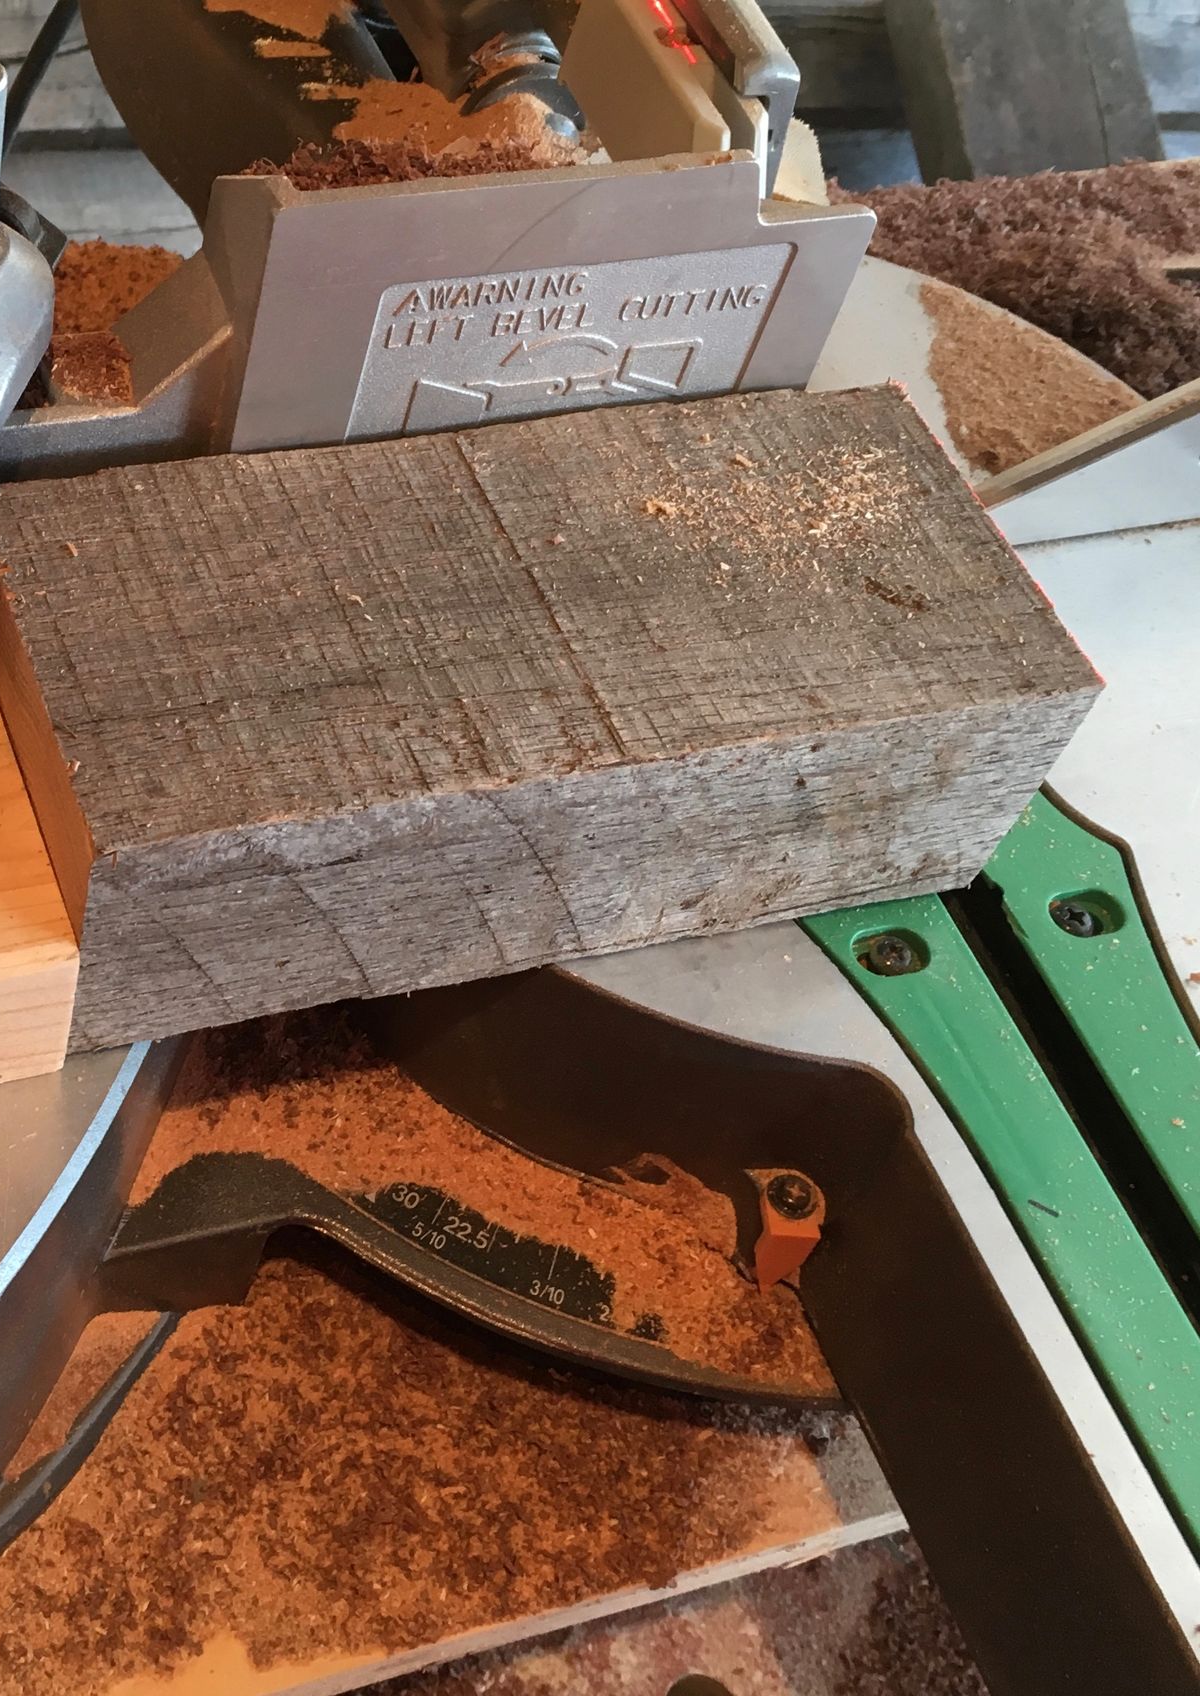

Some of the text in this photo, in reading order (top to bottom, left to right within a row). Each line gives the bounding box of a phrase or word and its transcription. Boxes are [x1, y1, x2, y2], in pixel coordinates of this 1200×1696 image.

[429, 272, 588, 311] WARNING
[384, 283, 767, 349] LEFT BEVEL CUTTING
[392, 1184, 420, 1209] 30
[411, 1221, 447, 1250] 5/10
[442, 1216, 490, 1249] 22.5
[529, 1279, 565, 1305] 3/10
